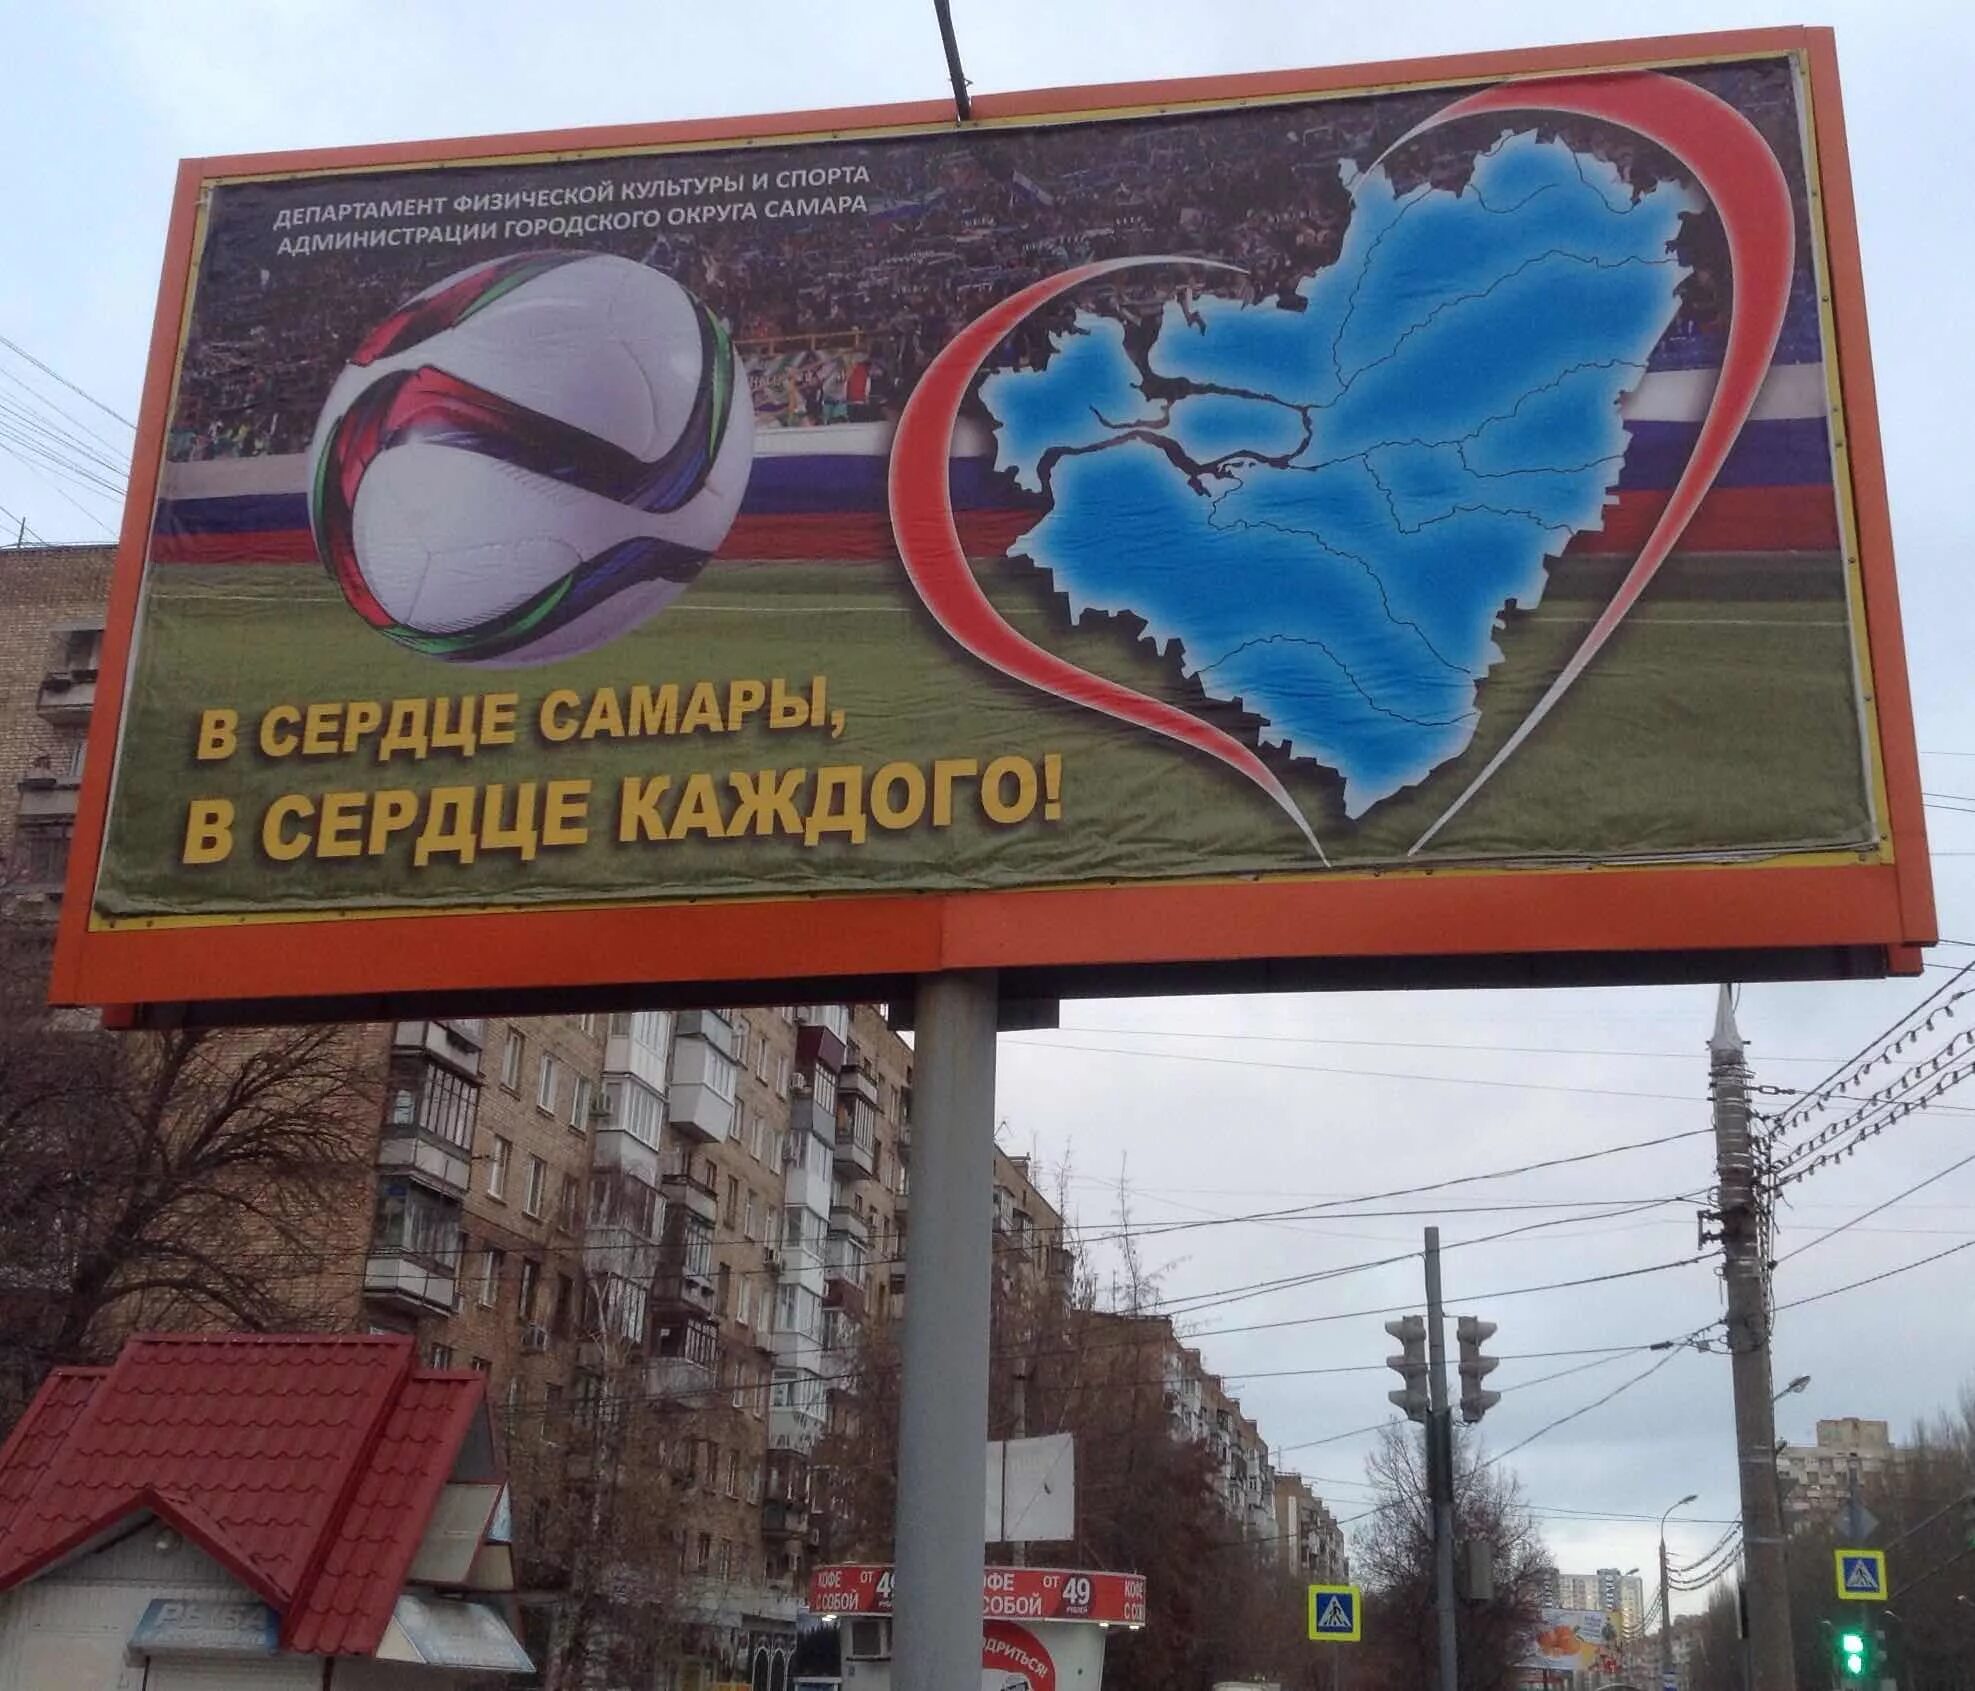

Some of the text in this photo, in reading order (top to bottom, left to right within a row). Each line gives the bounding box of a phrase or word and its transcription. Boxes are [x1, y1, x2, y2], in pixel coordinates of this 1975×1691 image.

[274, 165, 871, 229] ДЕПАРТАМЕНТ ФИЗИЧЕСКОЙ КУЛЬТУРЫ И СПОРТА
[276, 195, 868, 257] АДМИНИСТРАЦИИ ГОРОДСКОГО ОКРУГА САМАРА
[197, 675, 847, 762] В СЕРДЦЕ САМАРЫ,
[182, 752, 1063, 867] В СЕРДЦЕ КАЖДОГО!
[1043, 1575, 1060, 1588] ОТ
[1062, 1577, 1090, 1605] 49
